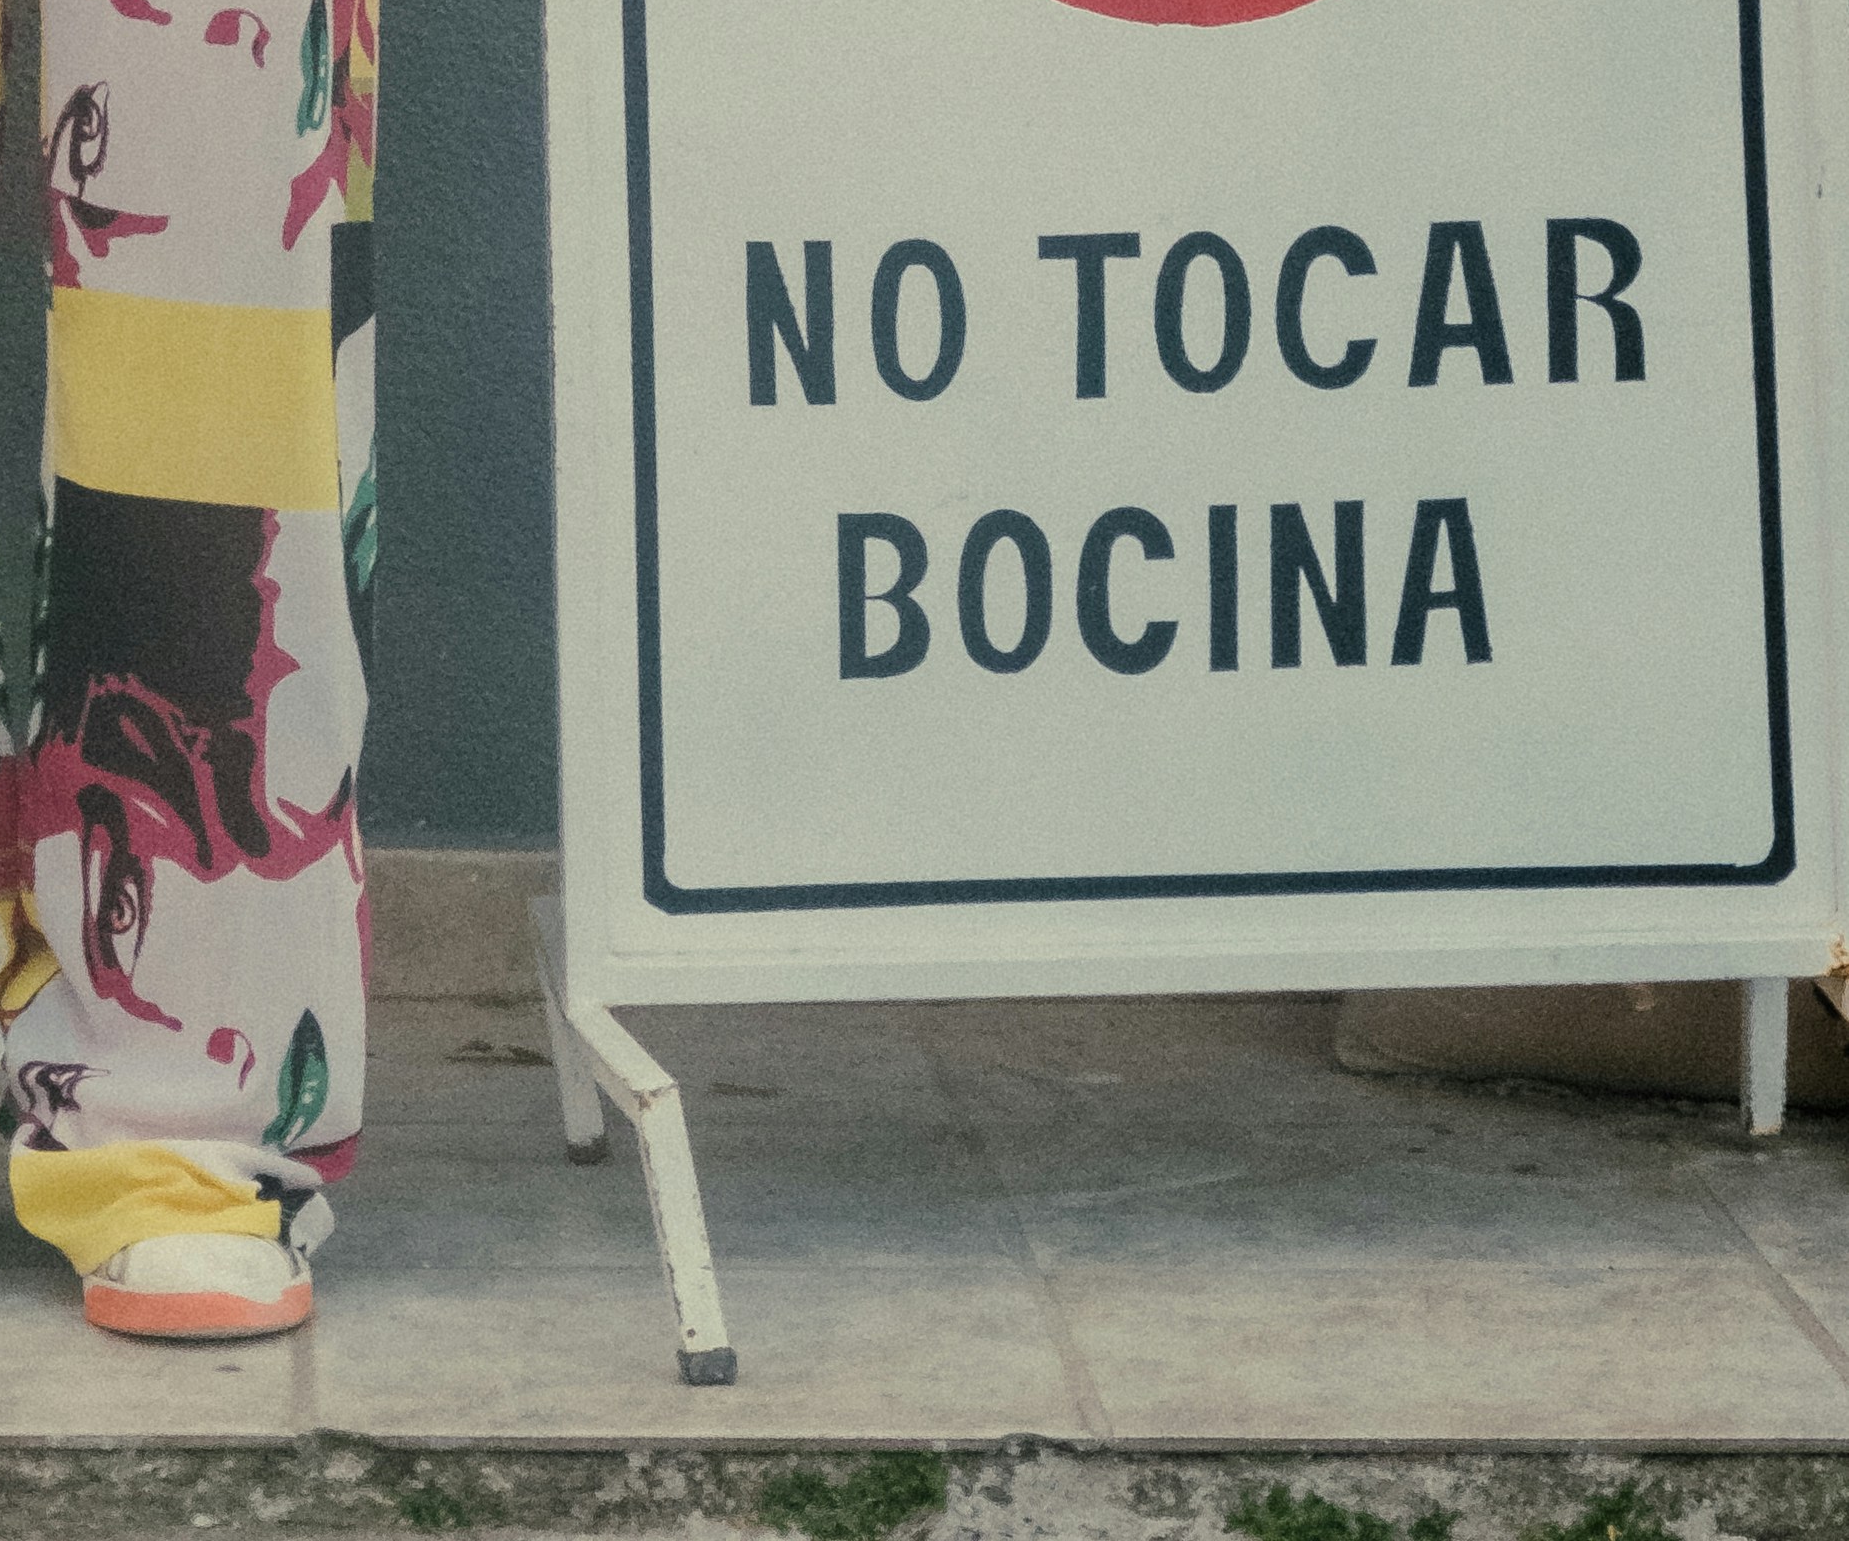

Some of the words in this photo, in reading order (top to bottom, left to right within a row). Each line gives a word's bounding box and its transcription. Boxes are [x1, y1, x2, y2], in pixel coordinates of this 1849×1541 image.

[744, 238, 968, 407] NO
[1037, 216, 1646, 400] TOCAR
[836, 496, 1493, 680] BOCINA
